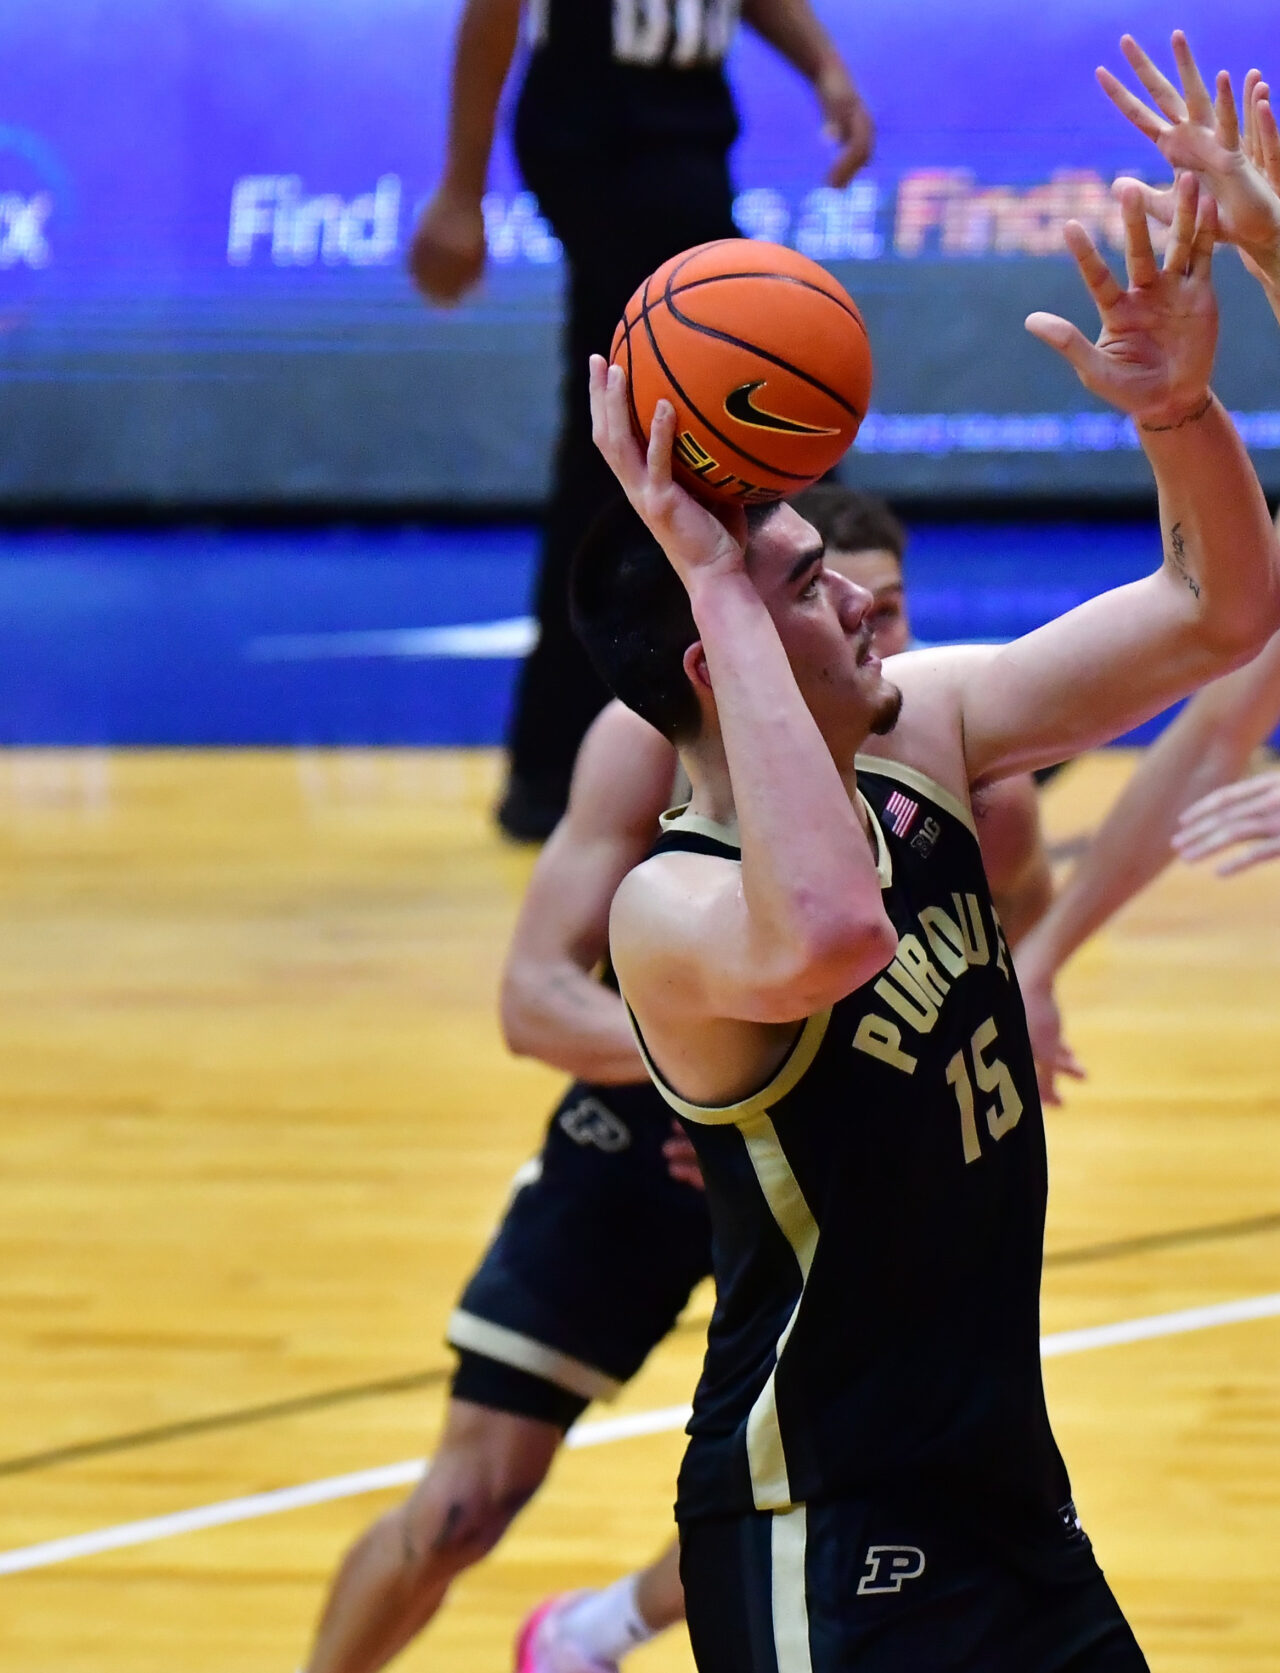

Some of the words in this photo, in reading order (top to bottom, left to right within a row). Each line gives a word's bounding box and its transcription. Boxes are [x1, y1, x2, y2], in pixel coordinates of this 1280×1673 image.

[227, 173, 401, 267] Find
[945, 1015, 1024, 1165] 15
[856, 1545, 926, 1595] P
